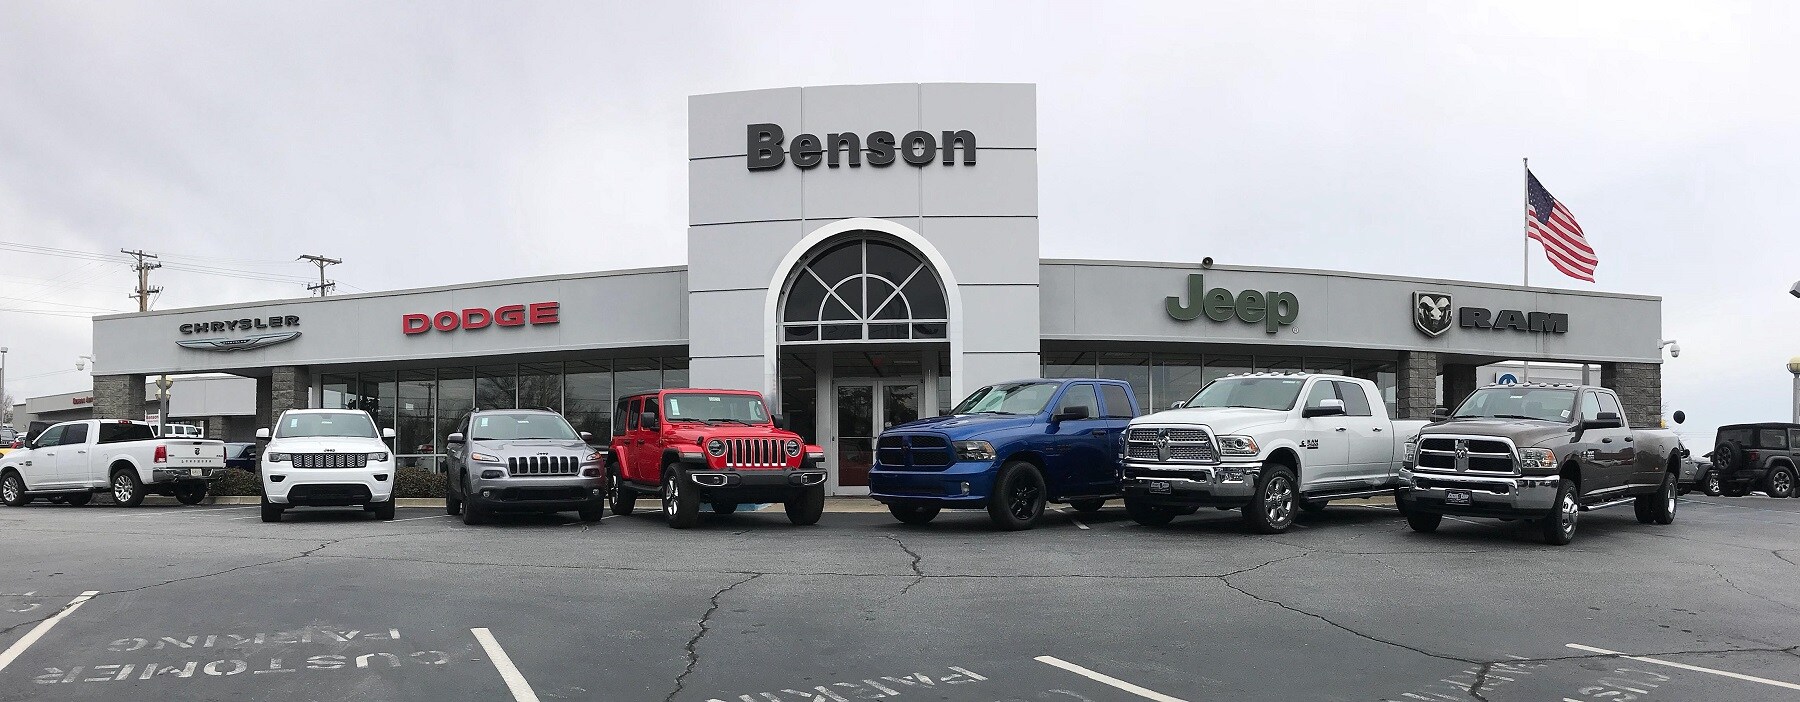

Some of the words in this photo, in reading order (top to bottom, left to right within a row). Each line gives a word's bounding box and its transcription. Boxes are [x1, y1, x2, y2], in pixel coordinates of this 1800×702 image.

[747, 123, 976, 171] Benson
[403, 302, 560, 336] DODGE
[1165, 274, 1299, 333] Jeep
[1459, 306, 1568, 333] RAM
[179, 315, 300, 334] CHRYSLER
[33, 650, 450, 685] CUSTOMER
